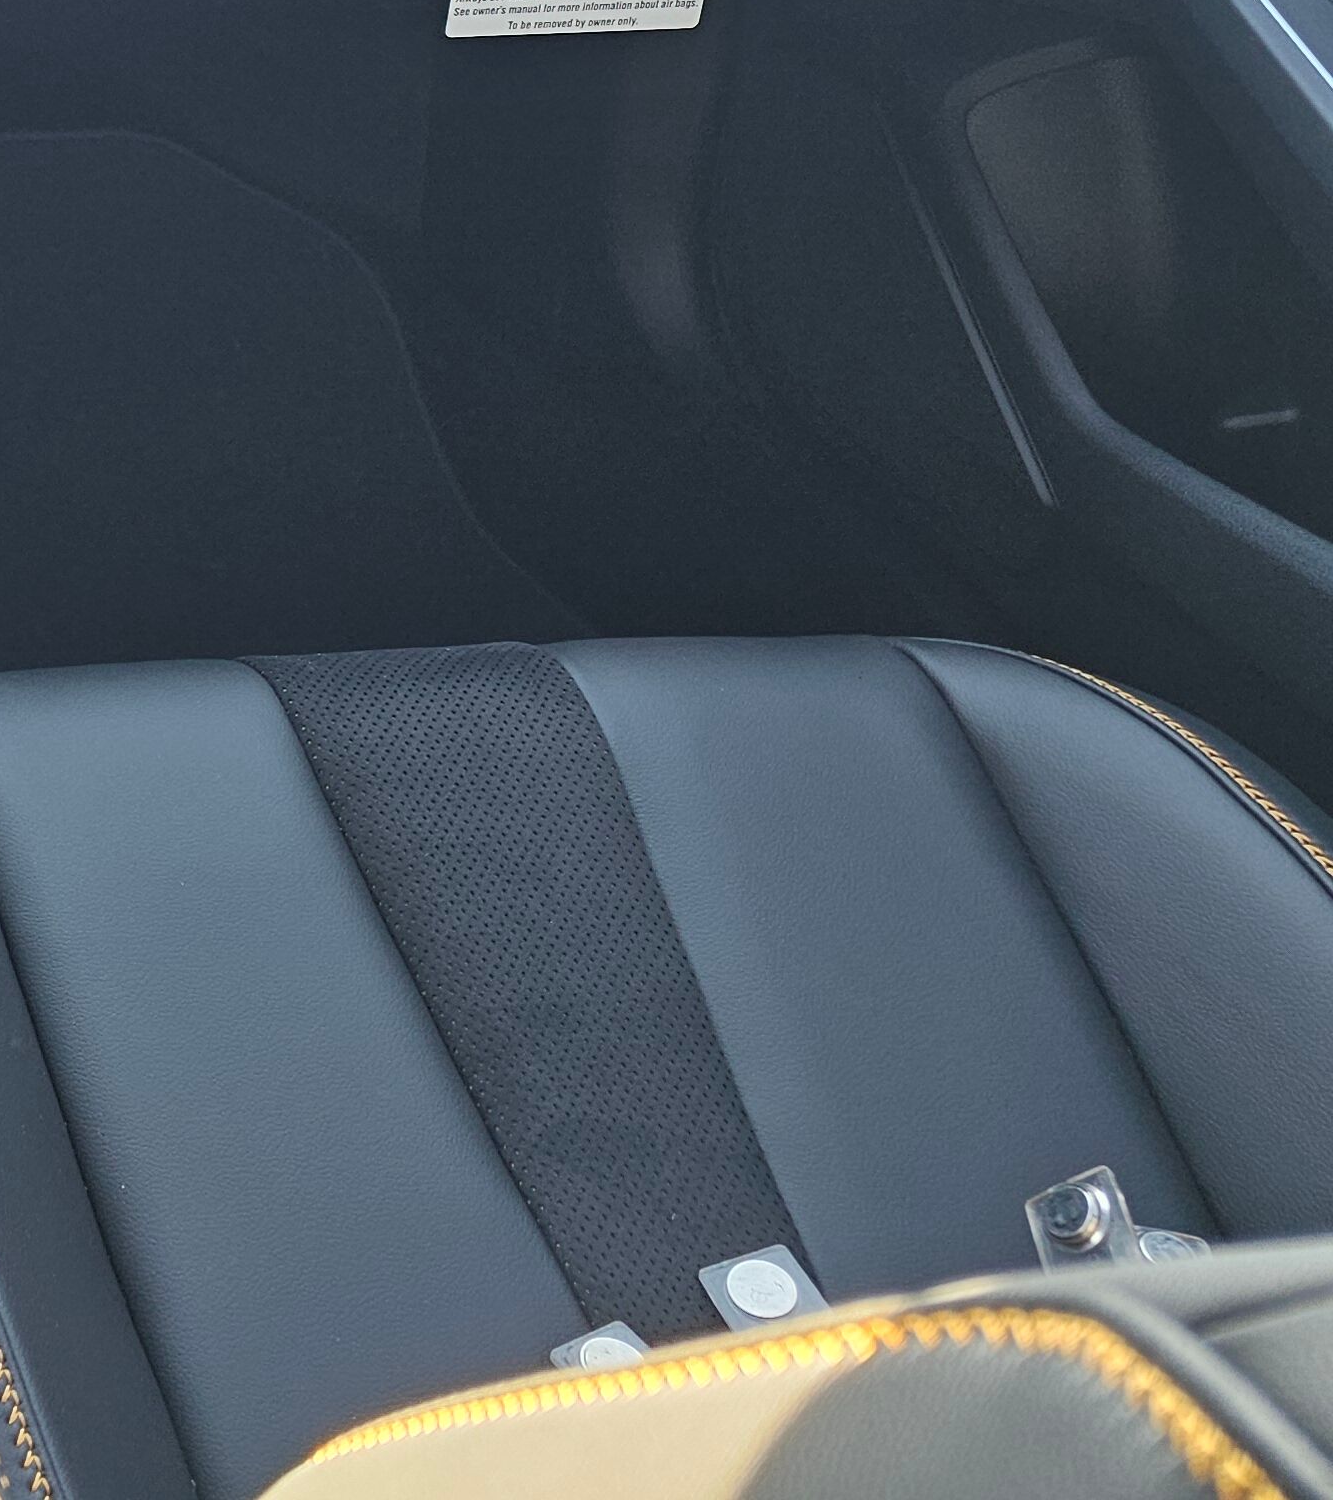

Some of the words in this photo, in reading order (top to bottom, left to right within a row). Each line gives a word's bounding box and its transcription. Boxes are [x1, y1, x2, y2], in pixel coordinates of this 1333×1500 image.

[508, 20, 518, 30] To
[520, 20, 531, 29] be
[533, 19, 573, 29] removed
[575, 19, 585, 28] by
[588, 18, 615, 26] owner
[618, 17, 638, 27] only.
